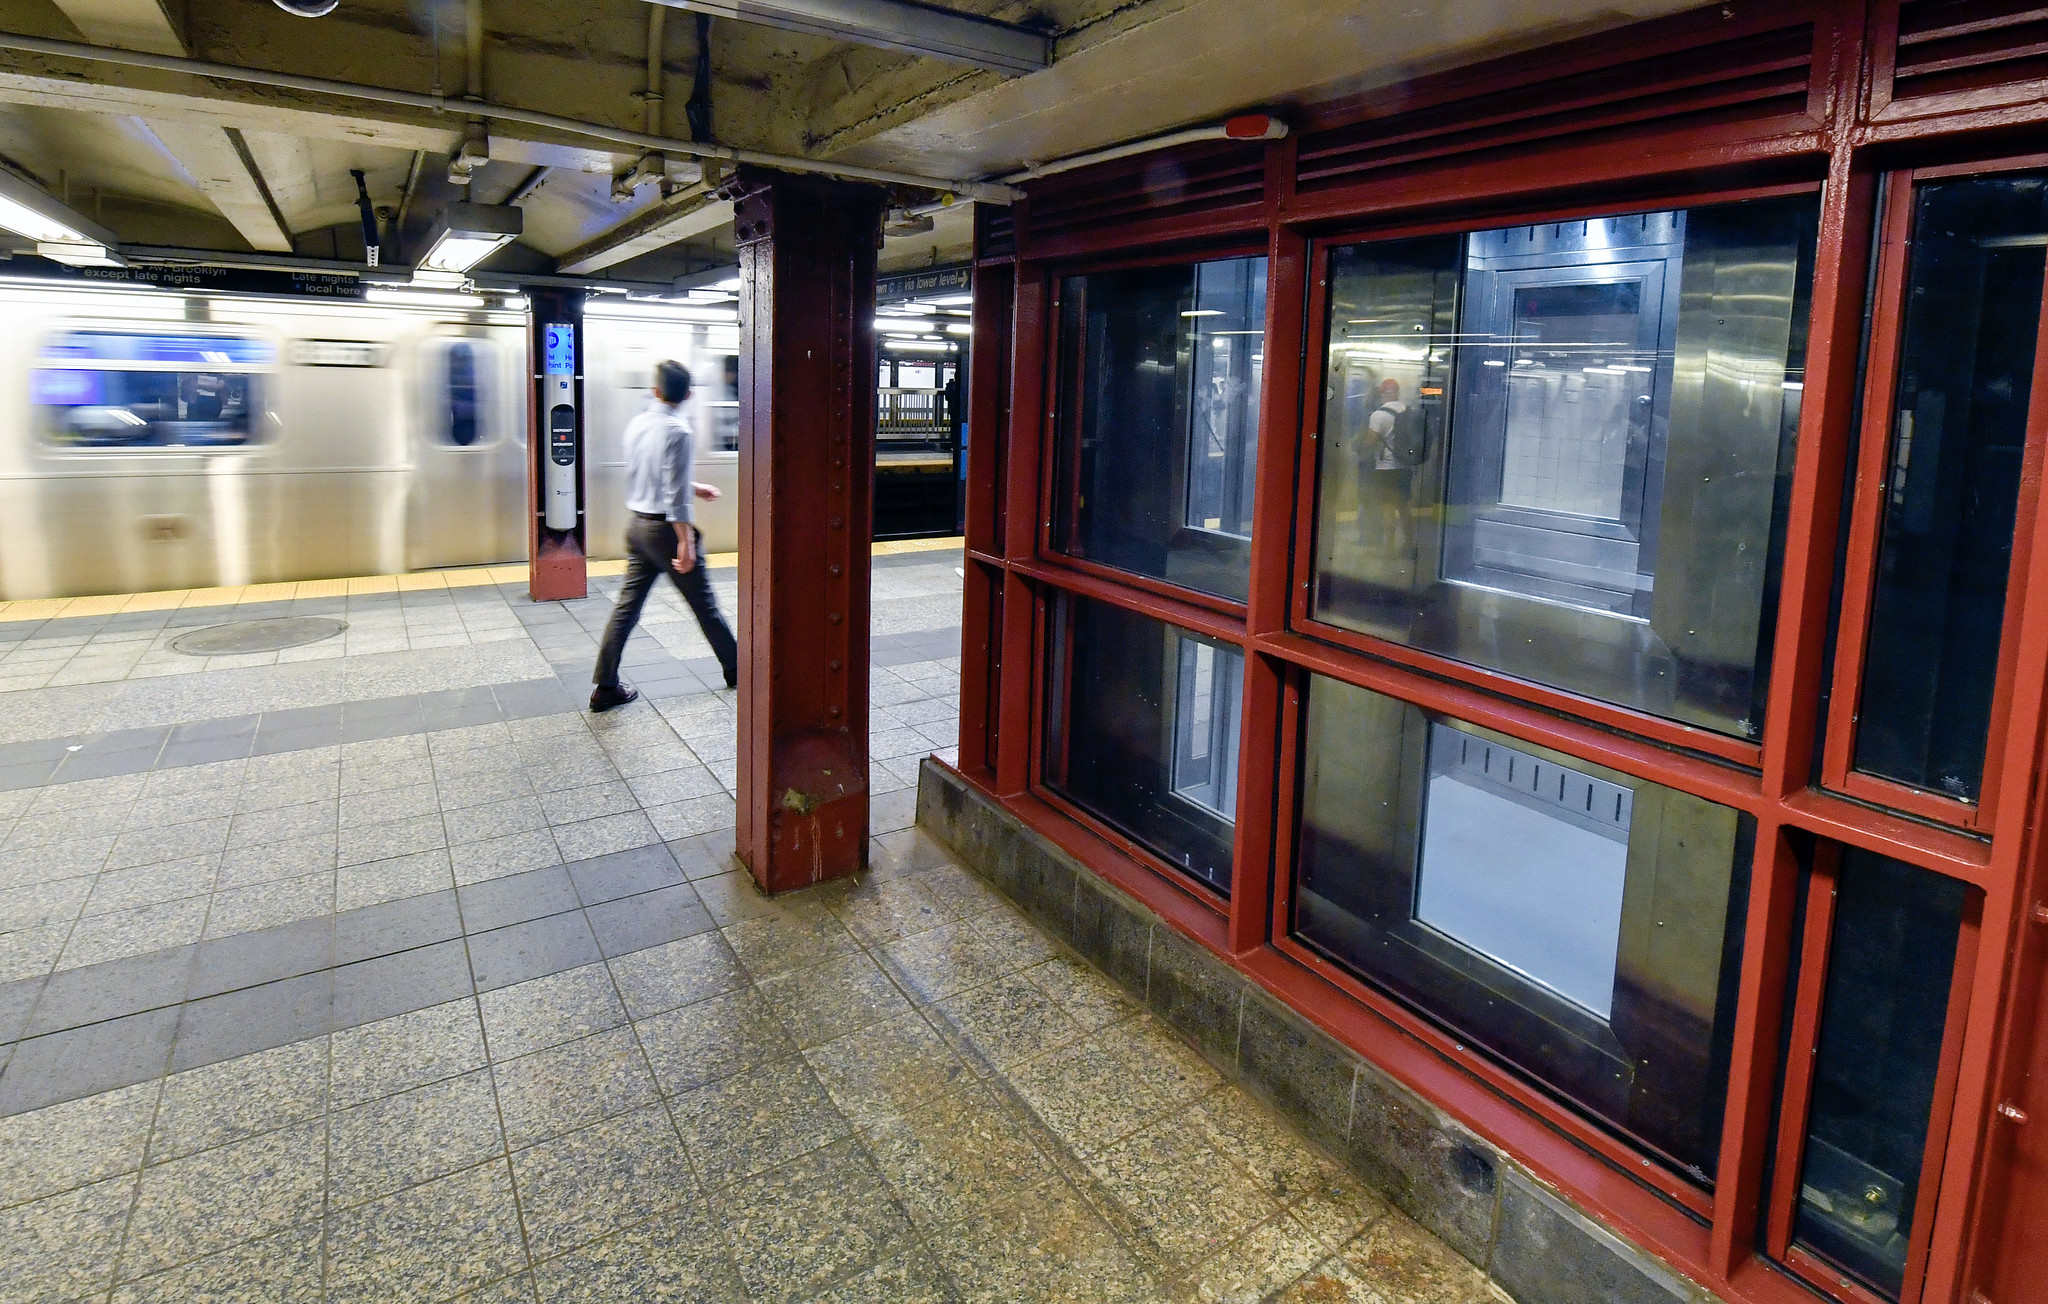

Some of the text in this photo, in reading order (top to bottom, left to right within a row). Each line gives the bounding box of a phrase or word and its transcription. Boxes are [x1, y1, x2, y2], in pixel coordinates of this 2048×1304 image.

[85, 268, 130, 280] except
[135, 270, 158, 281] late
[163, 272, 201, 284] nights
[172, 266, 227, 277] Brooklyn
[292, 272, 354, 285] Late nights
[904, 277, 915, 291] via
[916, 276, 937, 289] lower
[939, 271, 958, 286] level
[305, 283, 333, 293] local
[336, 285, 361, 294] here
